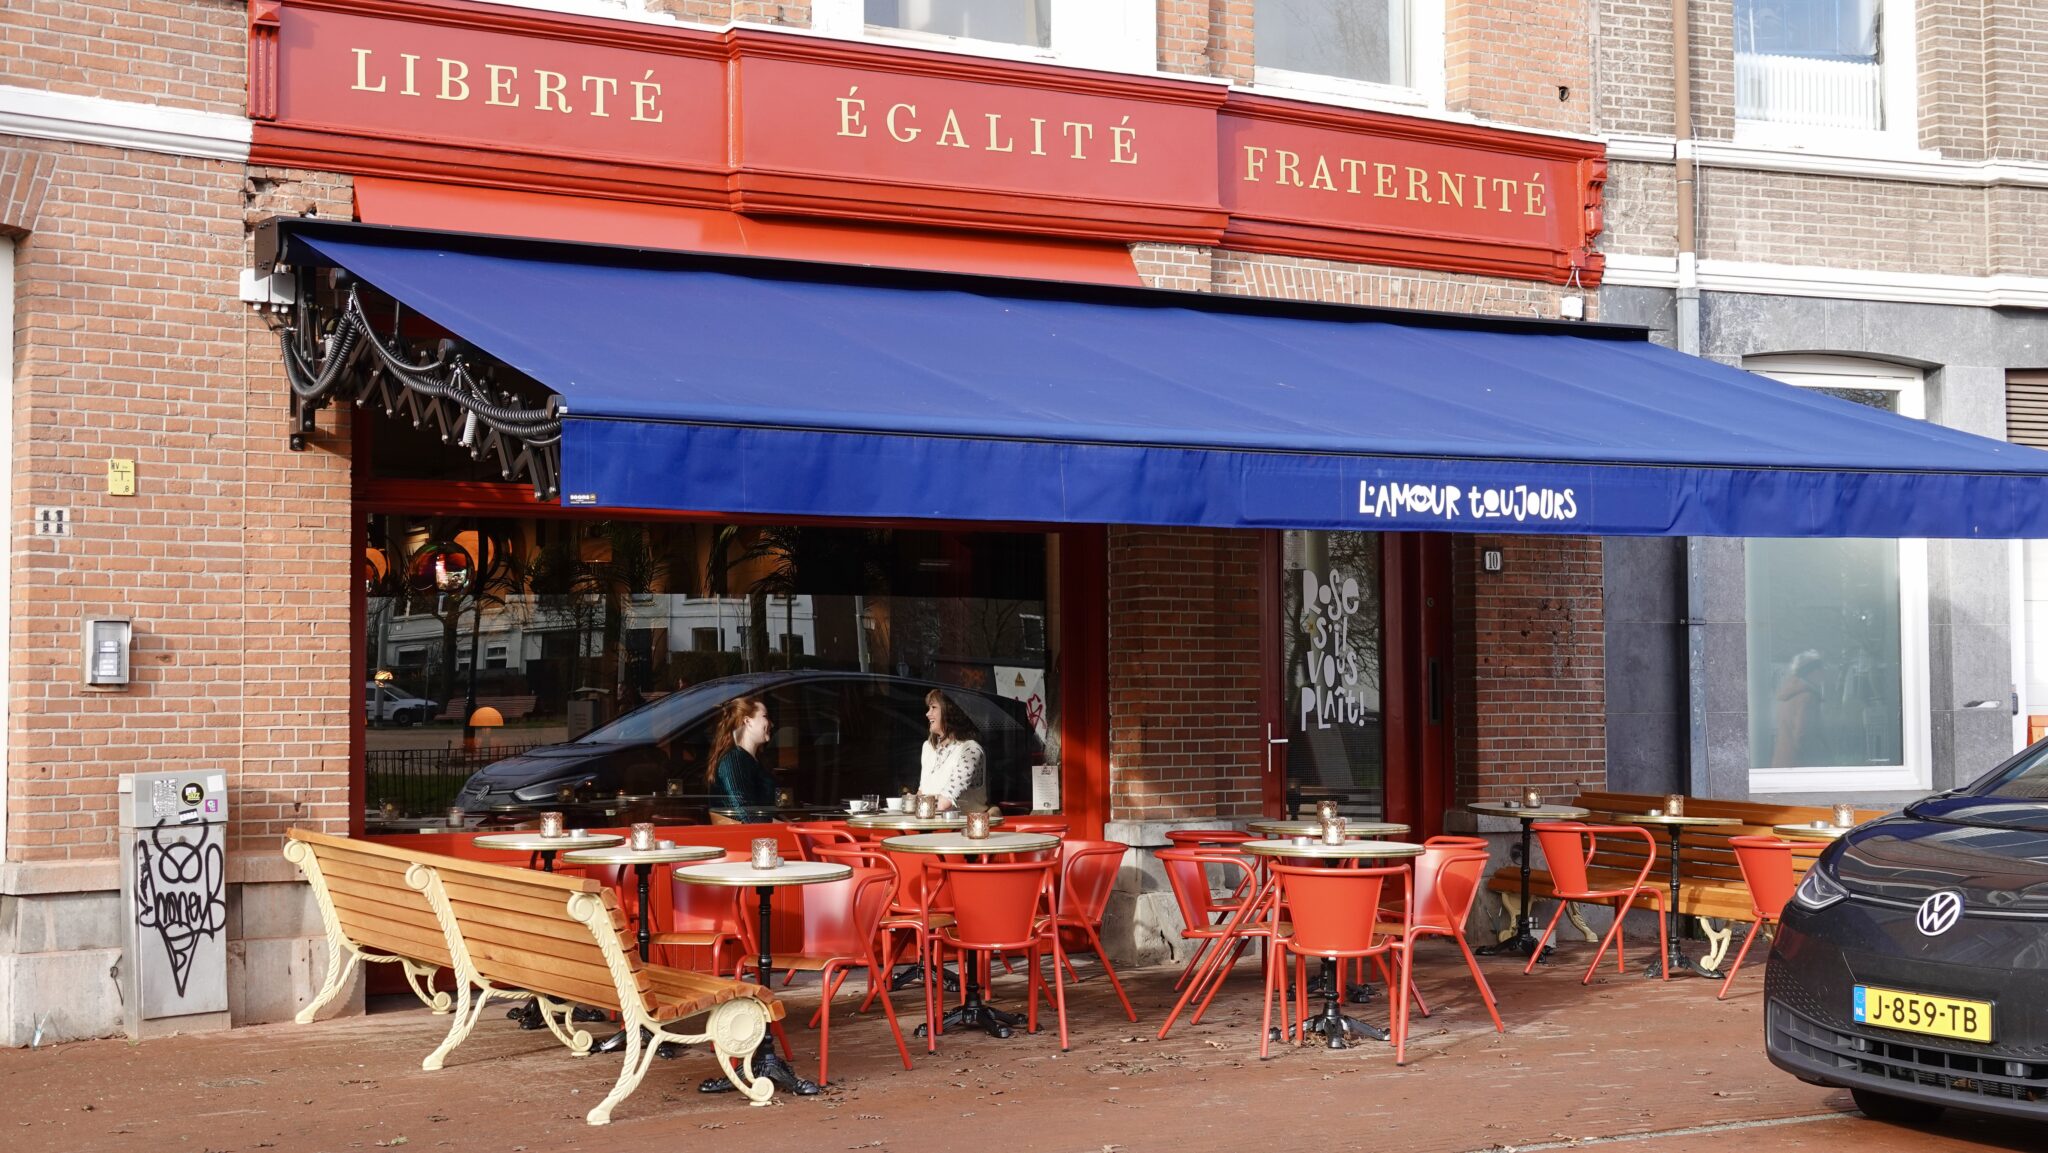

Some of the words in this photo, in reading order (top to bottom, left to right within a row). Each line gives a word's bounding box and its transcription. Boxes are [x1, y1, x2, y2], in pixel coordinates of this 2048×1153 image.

[351, 48, 663, 123] LIBERTÉ
[836, 86, 1138, 165] ÉGALITÉ
[1243, 145, 1547, 217] FRATERNITÉ
[1359, 480, 1461, 520] L'AMOUR
[1488, 552, 1498, 570] 10
[1855, 1007, 1864, 1016] NL
[1873, 995, 1977, 1033] J-859-TB
